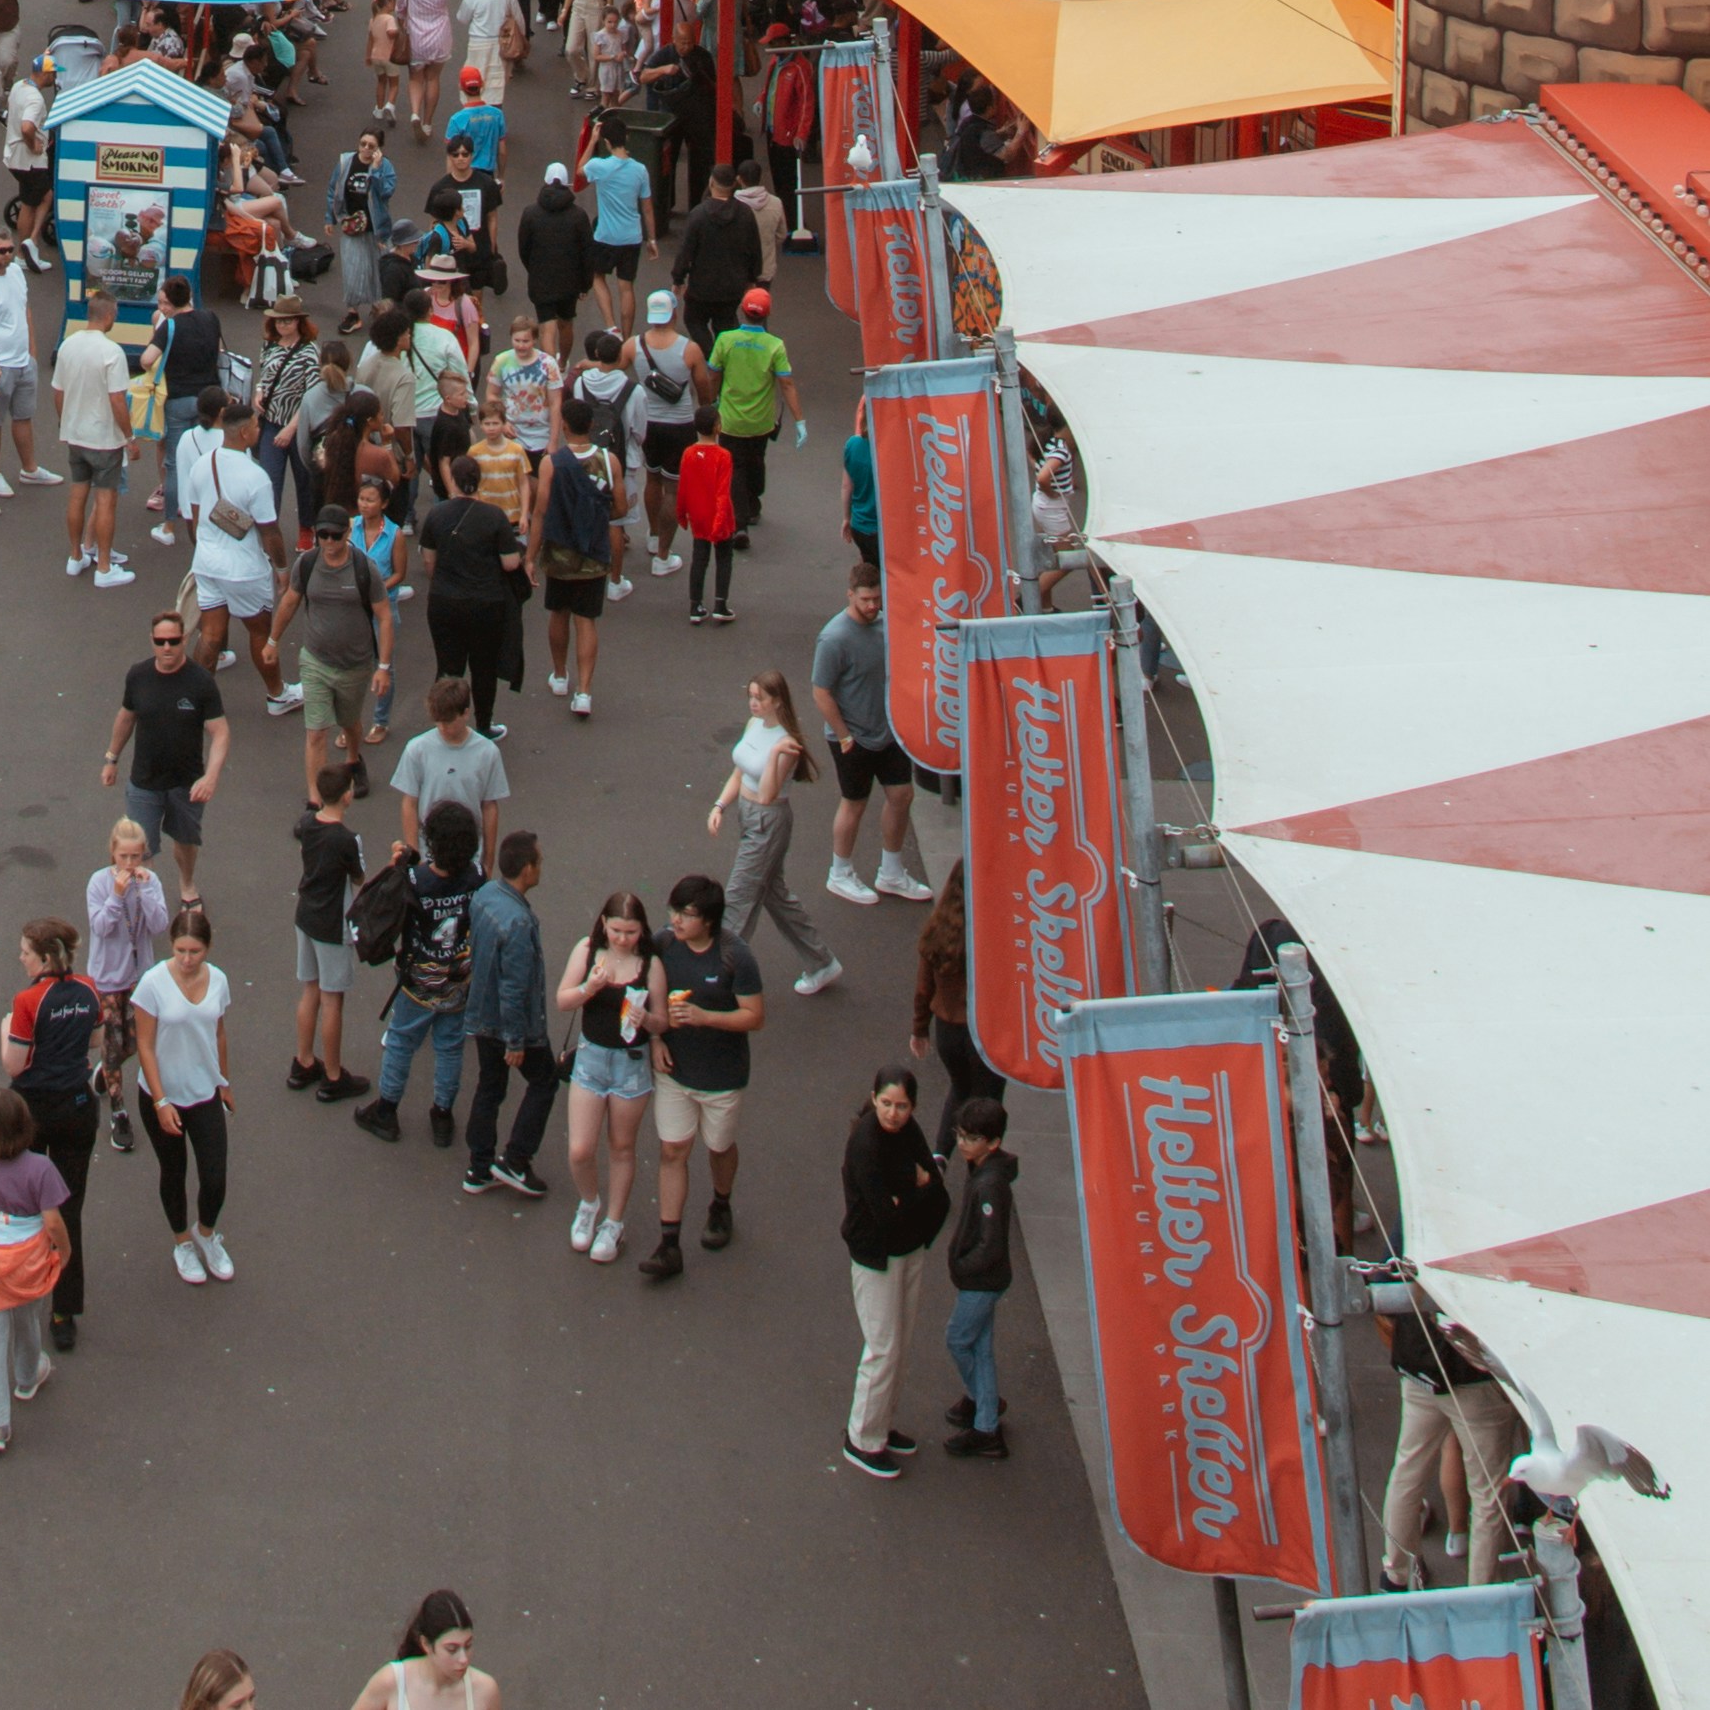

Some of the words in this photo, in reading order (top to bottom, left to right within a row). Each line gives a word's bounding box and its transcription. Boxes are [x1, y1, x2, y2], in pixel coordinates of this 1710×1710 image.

[90, 198, 126, 209] tooth?
[91, 188, 121, 200] Sweet
[101, 160, 159, 174] SMOKING
[102, 148, 140, 161] Please
[141, 150, 159, 162] NO
[128, 269, 155, 279] GELATO
[882, 222, 924, 345] Helter
[917, 412, 963, 565] Helter
[913, 484, 929, 557] LUNA
[921, 597, 932, 671] PARK
[1012, 676, 1065, 857] Helter
[432, 916, 458, 948] 4
[436, 892, 475, 907] TOYOT
[1004, 758, 1020, 844] LUNA
[1012, 890, 1029, 973] PARK
[1025, 868, 1084, 1069] Skelter
[1138, 1073, 1220, 1289] Helter
[1131, 1182, 1159, 1287] LUNA
[1152, 1340, 1180, 1442] PARK
[1169, 1302, 1247, 1541] Skelter
